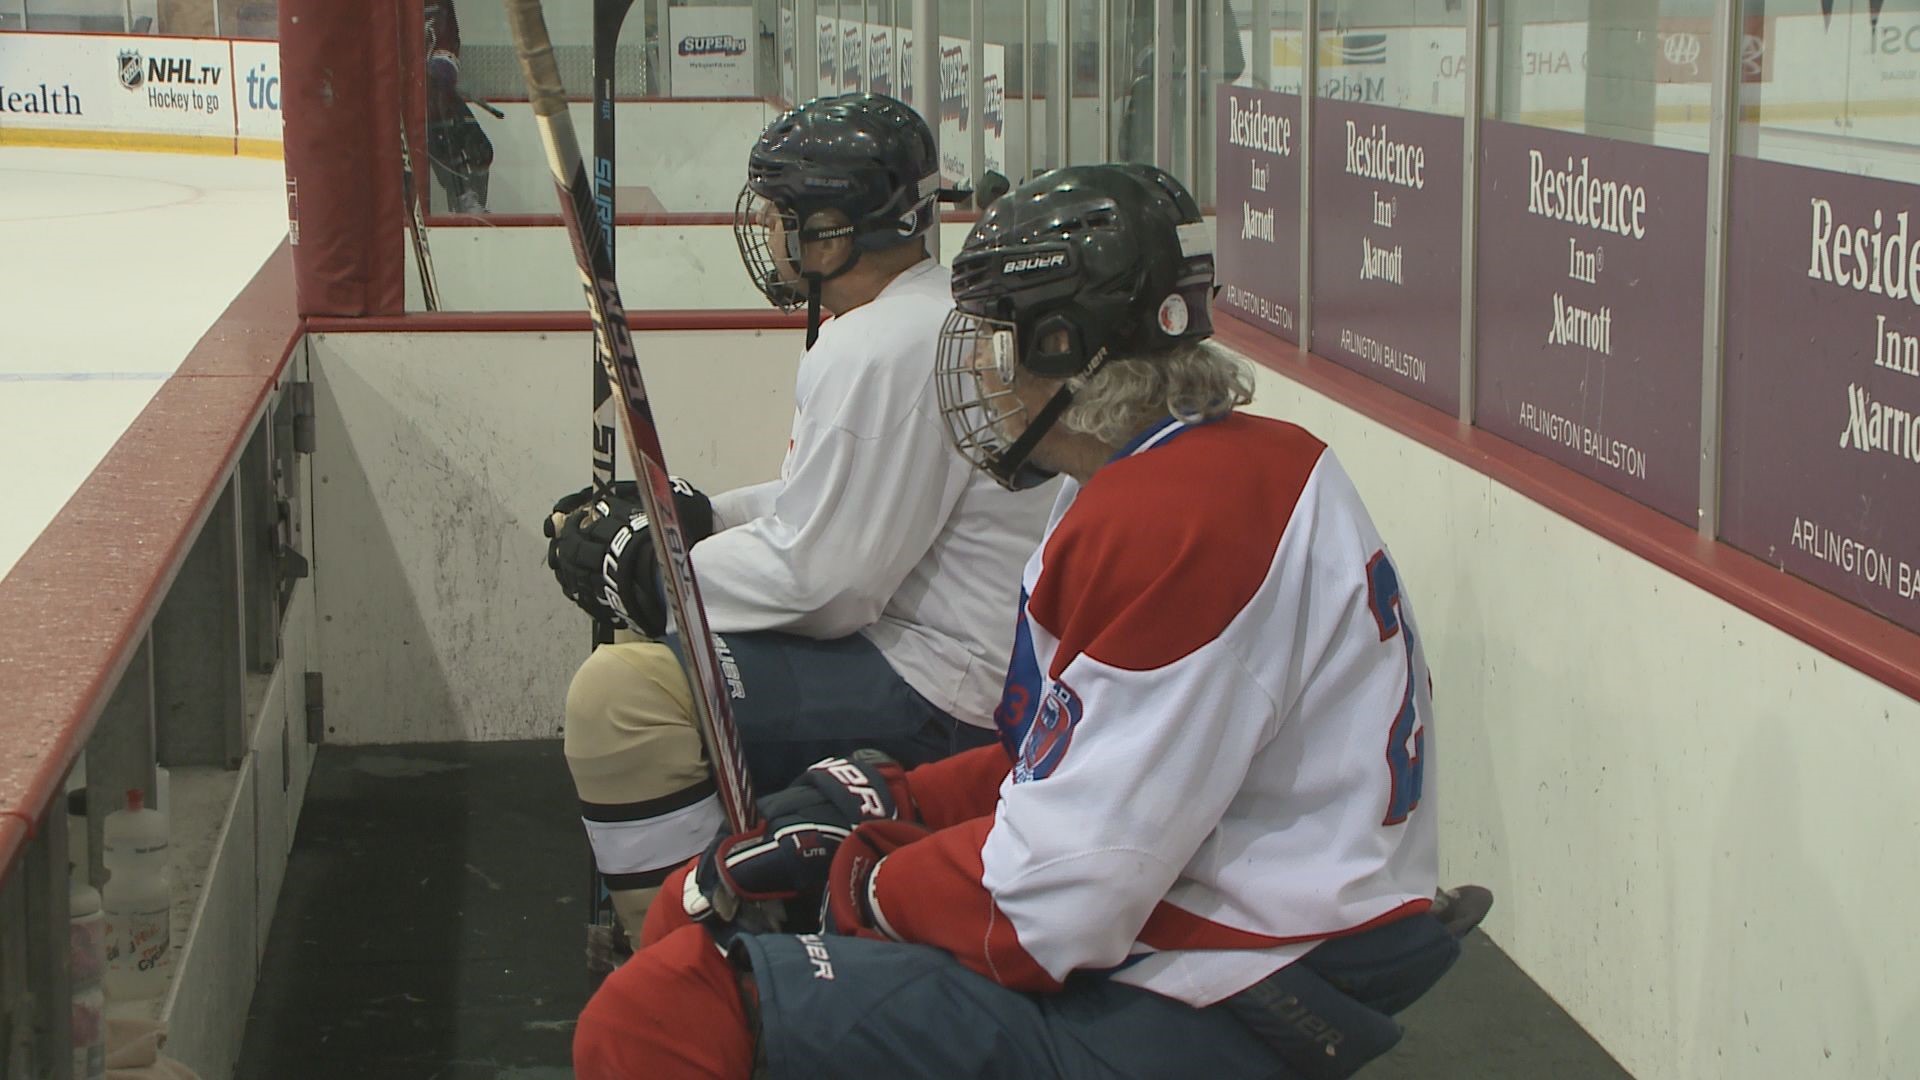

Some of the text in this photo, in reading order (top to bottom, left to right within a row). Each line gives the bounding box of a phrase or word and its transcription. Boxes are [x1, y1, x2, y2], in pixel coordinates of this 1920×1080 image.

[148, 57, 221, 85] NHL.TV
[246, 64, 281, 110] tic
[0, 83, 83, 115] ealth
[149, 87, 219, 114] Hockey to go
[1229, 96, 1291, 157] Residence
[1345, 120, 1425, 189] Residence
[1528, 149, 1647, 240] Residence
[1241, 200, 1275, 243] Marriott
[1003, 254, 1064, 275] BAUER
[1360, 236, 1403, 285] Marriott
[1226, 284, 1293, 330] ARLINGTON BALLSTON
[1548, 293, 1612, 355] Marriott
[1340, 328, 1426, 384] ARLINGTON BALLSTON
[1519, 401, 1647, 480] ARLINGTON BALLSTON
[1791, 516, 1892, 590] ARLINGTON
